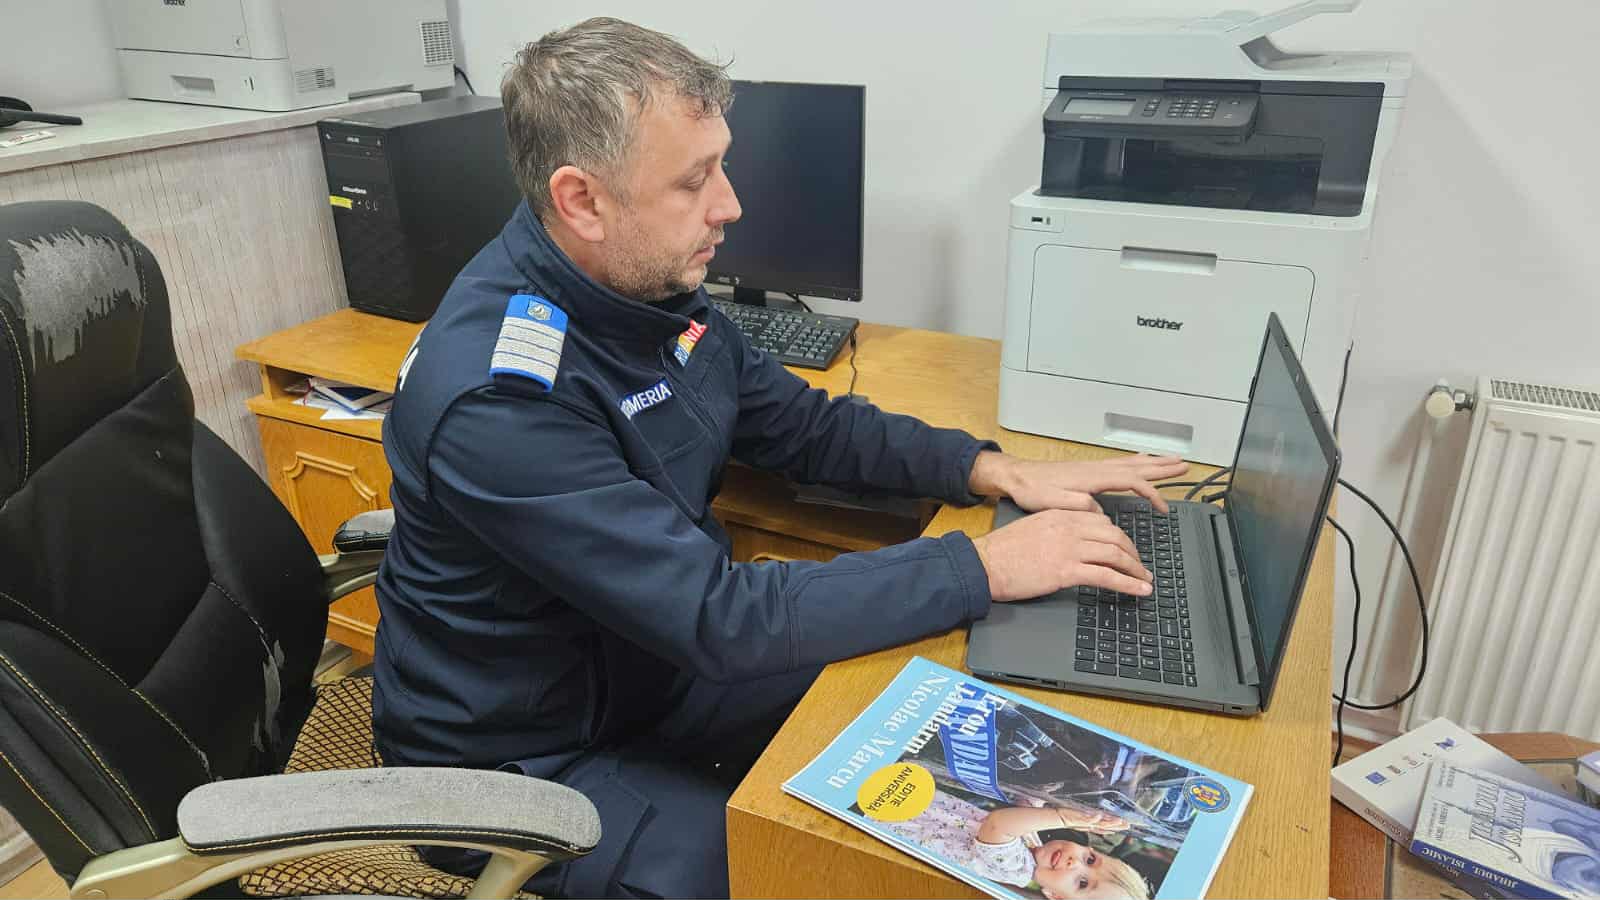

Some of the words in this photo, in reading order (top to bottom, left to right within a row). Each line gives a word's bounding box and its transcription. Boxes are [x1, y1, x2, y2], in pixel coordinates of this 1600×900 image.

[1136, 314, 1184, 331] brother
[883, 669, 951, 732] Nicolae
[902, 680, 977, 755] Jandarm
[959, 692, 1009, 737] Erou
[825, 731, 897, 789] Marcu
[1421, 847, 1466, 870] ISLAMIC
[1472, 864, 1519, 889] JIHADUL
